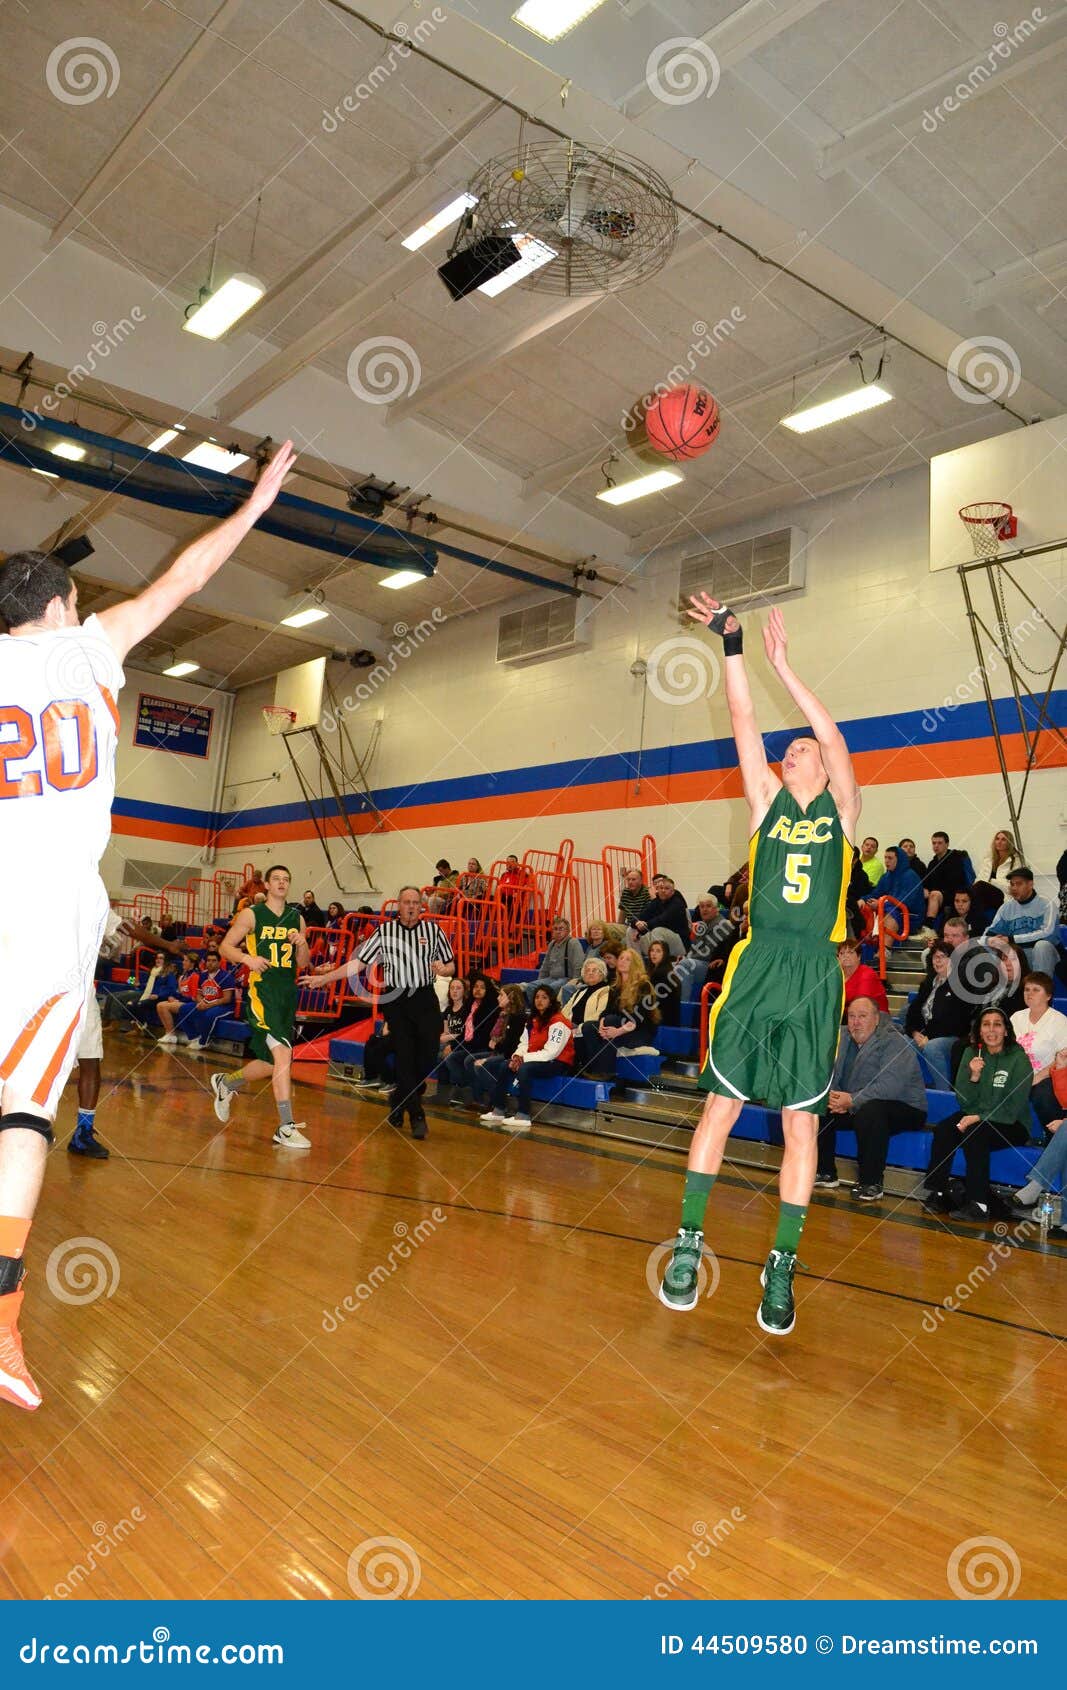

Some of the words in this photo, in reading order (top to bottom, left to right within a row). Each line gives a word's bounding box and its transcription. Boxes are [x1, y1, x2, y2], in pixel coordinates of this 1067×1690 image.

[0, 698, 98, 800] 20
[782, 853, 812, 904] 5
[269, 942, 293, 968] 12
